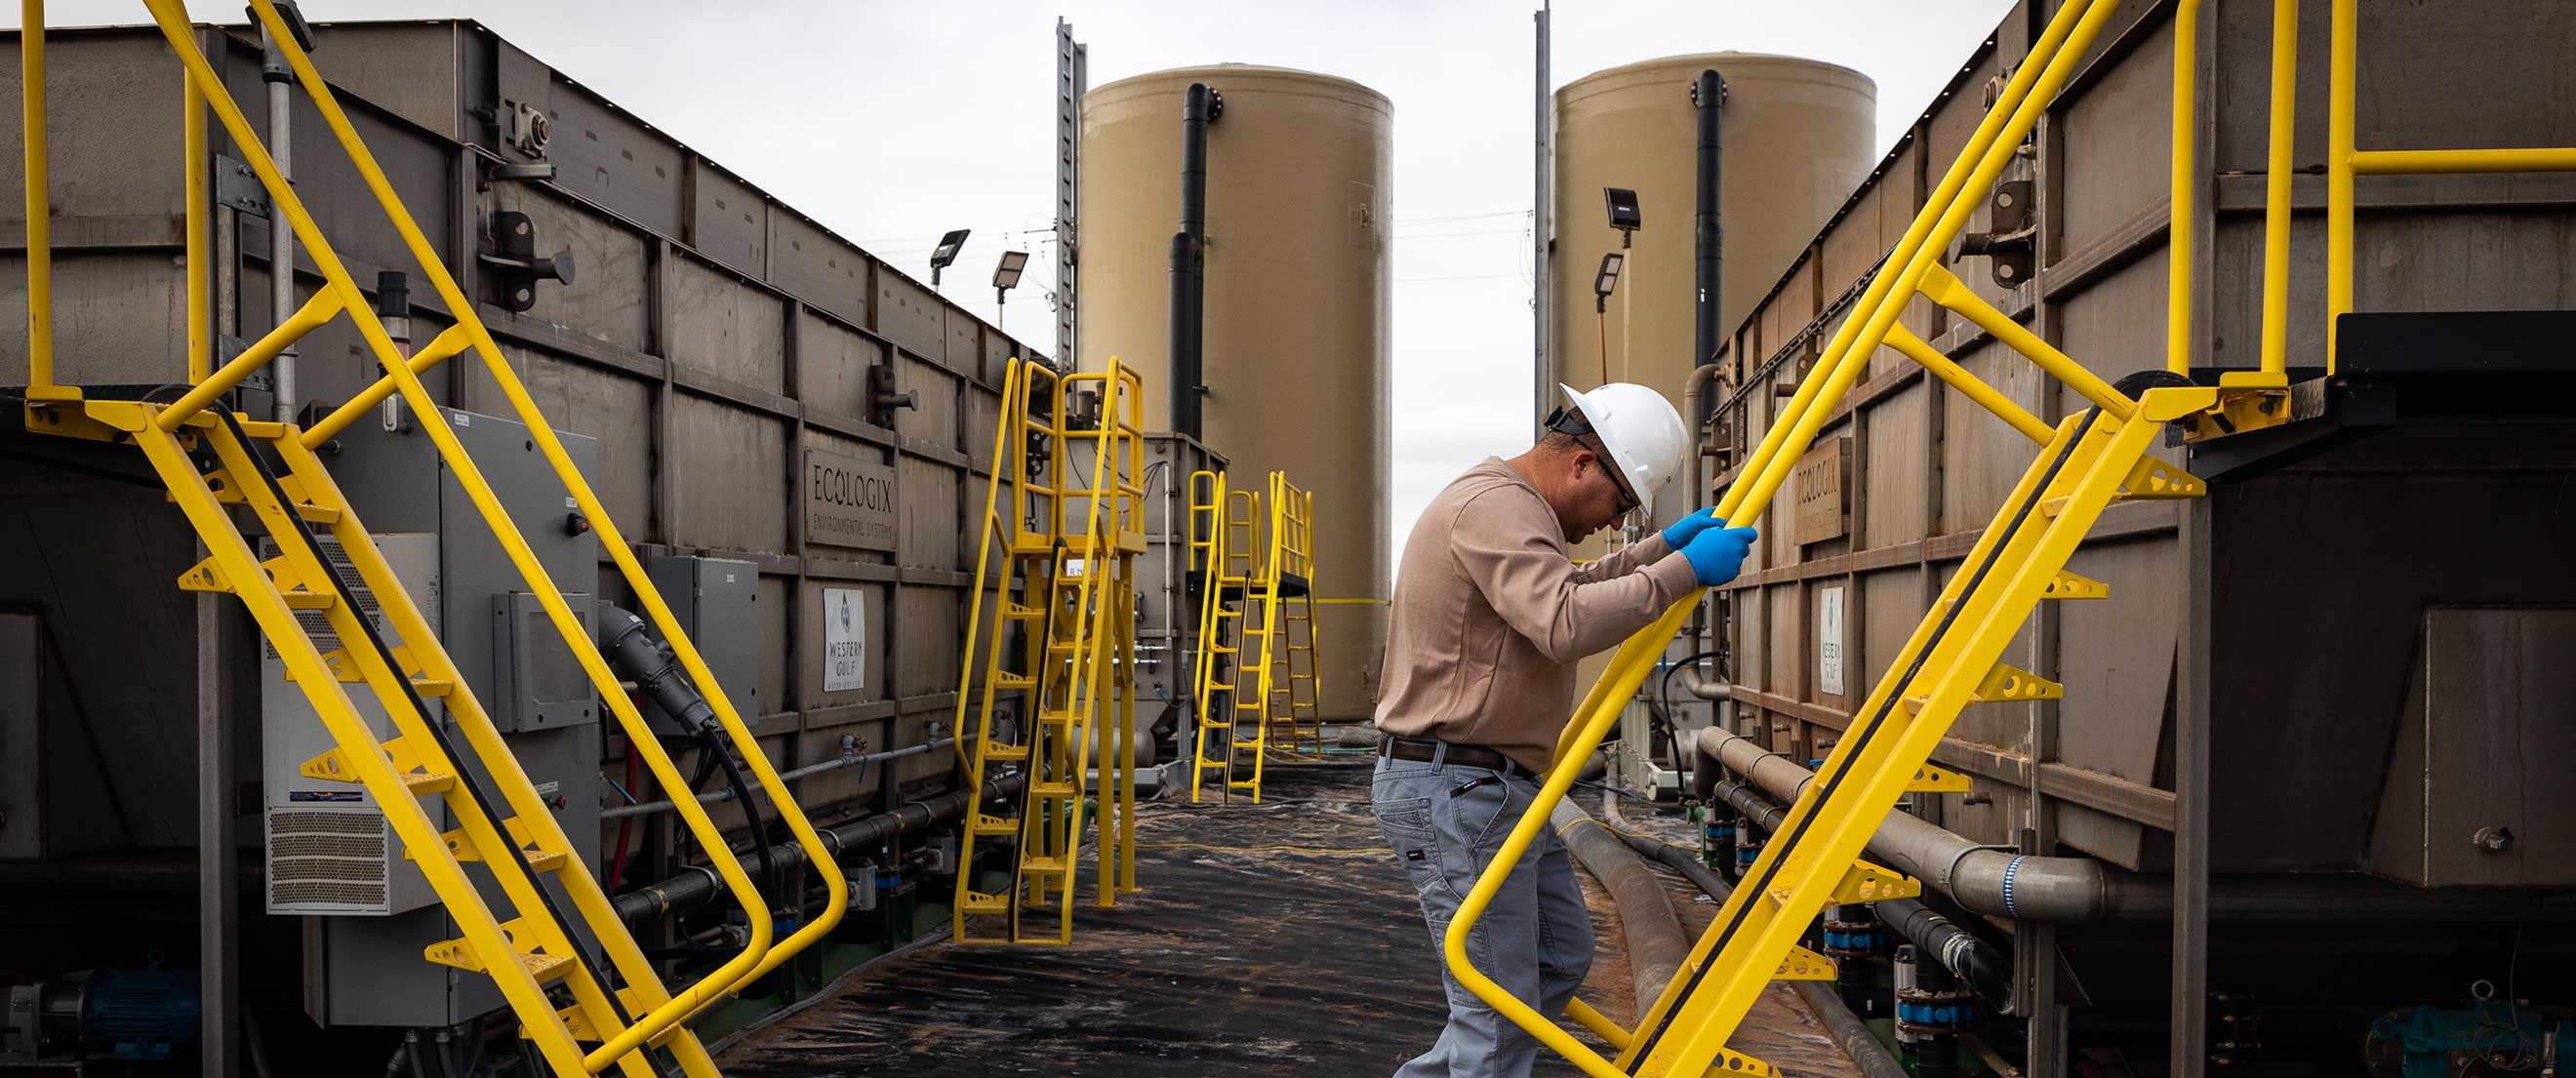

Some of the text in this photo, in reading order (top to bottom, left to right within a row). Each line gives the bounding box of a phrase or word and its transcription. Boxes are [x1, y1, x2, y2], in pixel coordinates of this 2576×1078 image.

[814, 464, 891, 513] ECOLOGIX
[1797, 456, 1836, 506] ECOLOGIX
[814, 513, 892, 539] ENVIRONMENTAL SYSTEMS
[828, 642, 862, 658] WESTERN
[836, 660, 856, 676] GULF
